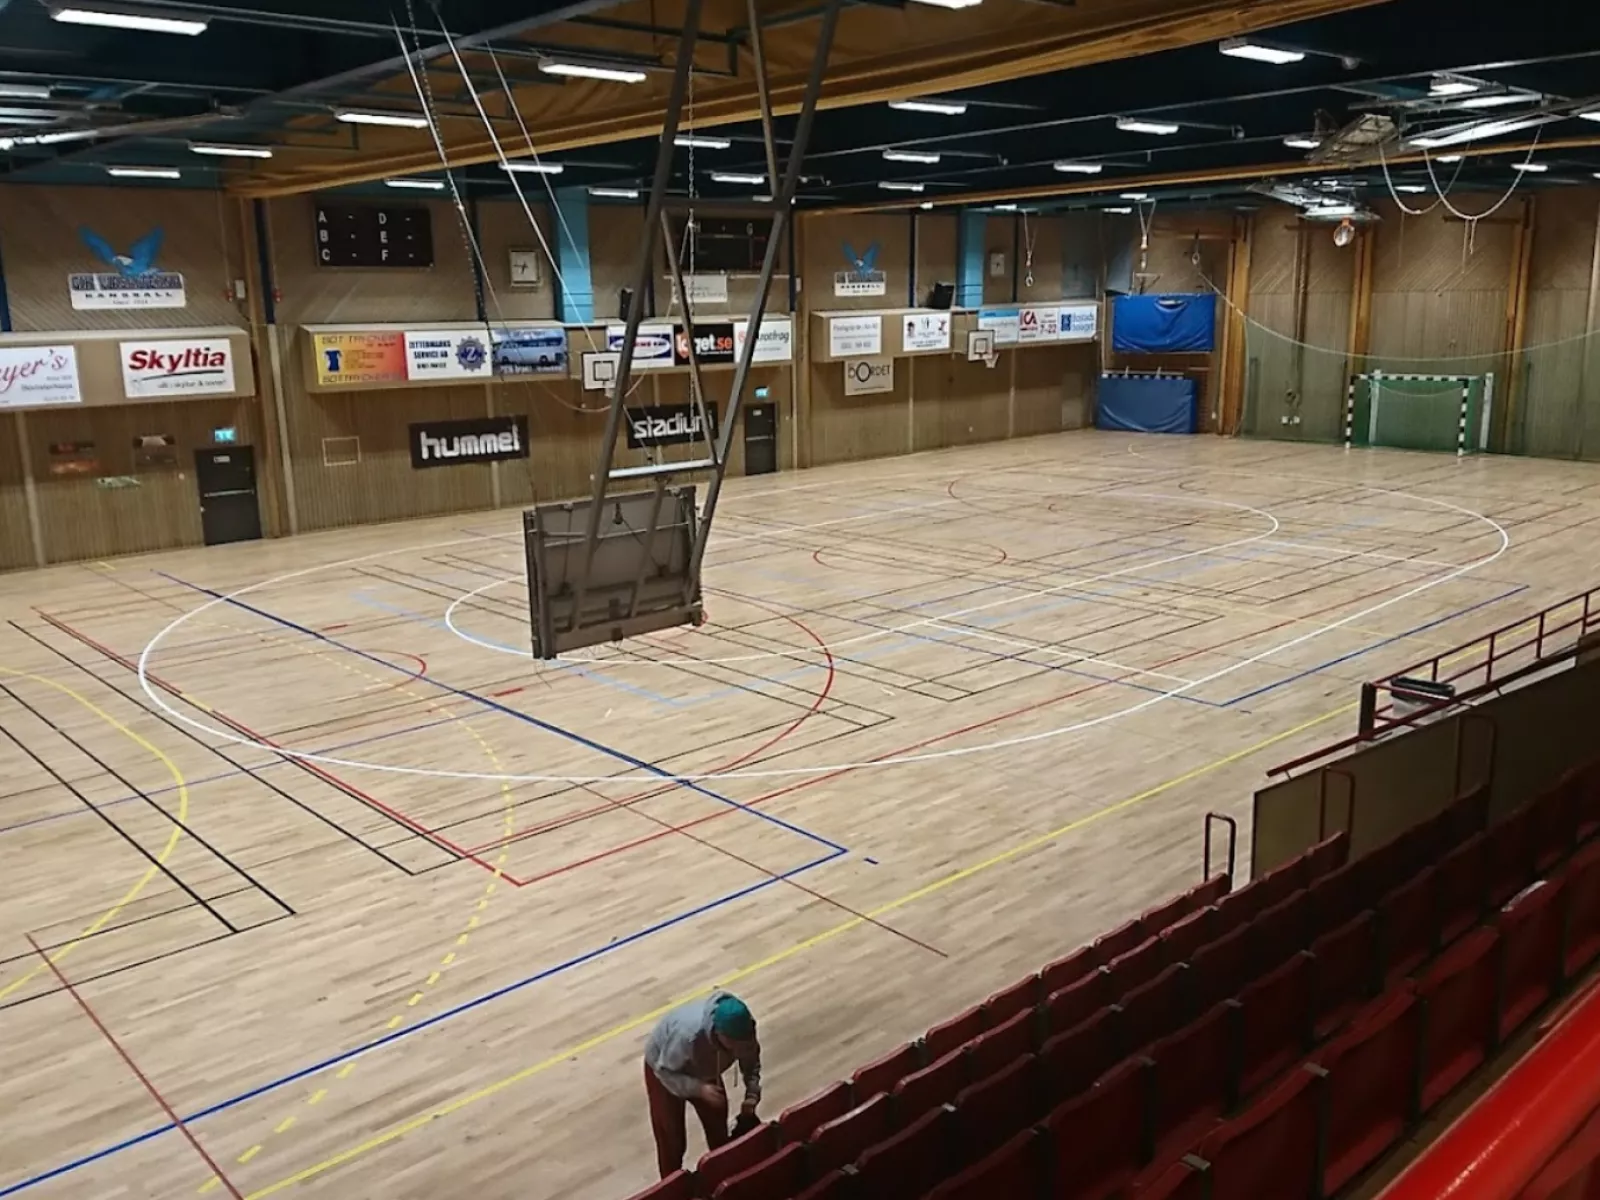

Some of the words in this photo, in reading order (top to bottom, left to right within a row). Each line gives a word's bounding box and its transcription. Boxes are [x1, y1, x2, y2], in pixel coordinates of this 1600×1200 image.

[319, 211, 327, 222] A
[379, 213, 387, 224] D
[320, 229, 328, 242] B
[380, 231, 388, 243] E
[321, 249, 330, 261] C
[381, 249, 388, 261] F
[1020, 310, 1037, 325] ICA
[129, 347, 226, 373] Skyltia
[0, 348, 68, 394] yer's
[420, 424, 520, 460] hummel
